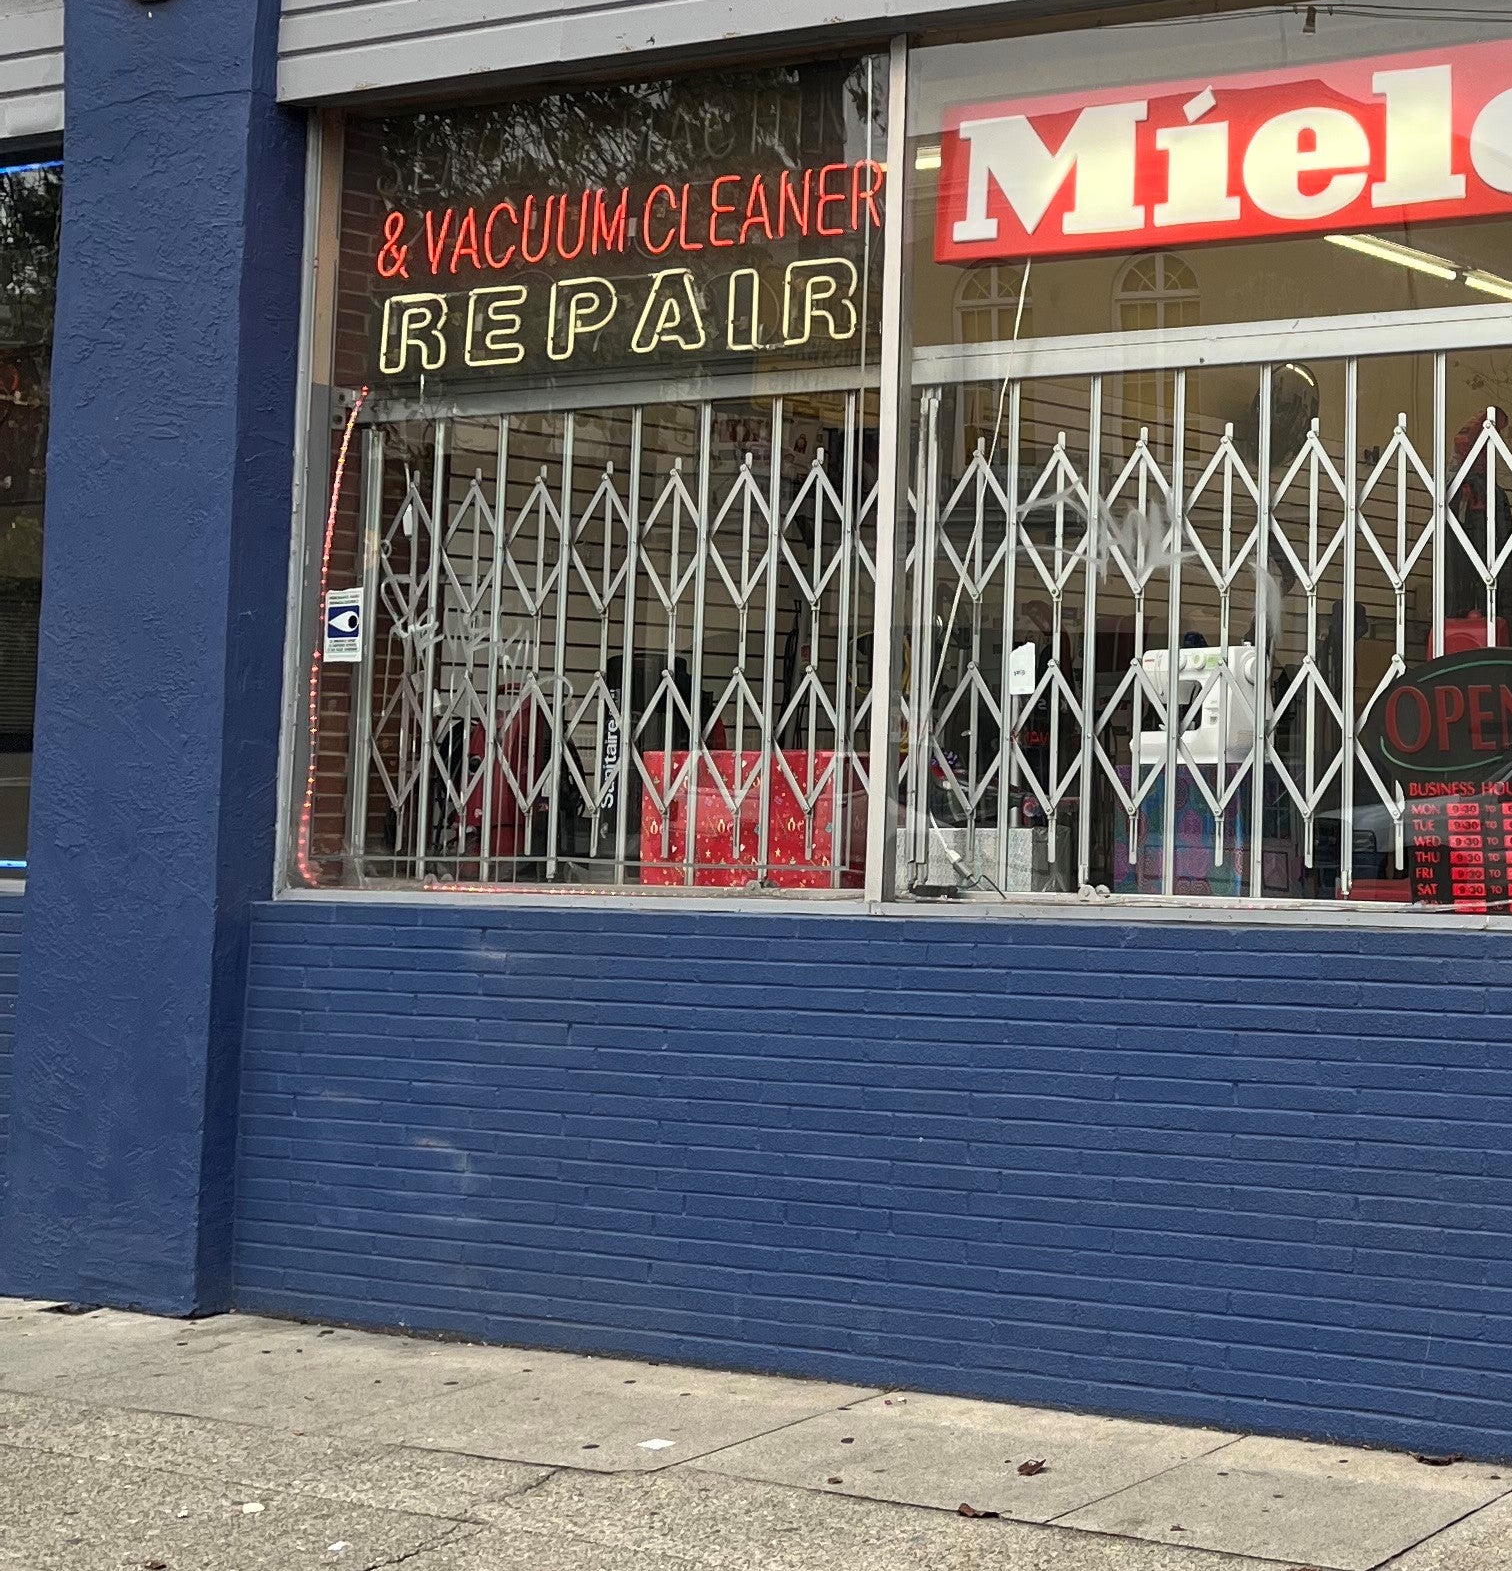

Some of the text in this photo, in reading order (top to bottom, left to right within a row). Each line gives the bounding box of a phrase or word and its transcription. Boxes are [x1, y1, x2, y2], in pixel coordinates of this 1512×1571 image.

[376, 211, 410, 279] &
[424, 185, 630, 275] VACUUM
[642, 158, 884, 255] CLEANER
[379, 257, 860, 375] REPAIR
[1409, 781, 1476, 797] BUSINESS
[1411, 803, 1440, 815] MON
[1412, 819, 1435, 831] TUE
[1413, 836, 1441, 847] WED
[1415, 851, 1440, 863] THU
[1415, 867, 1434, 879] FRI
[1416, 883, 1439, 895] SAT
